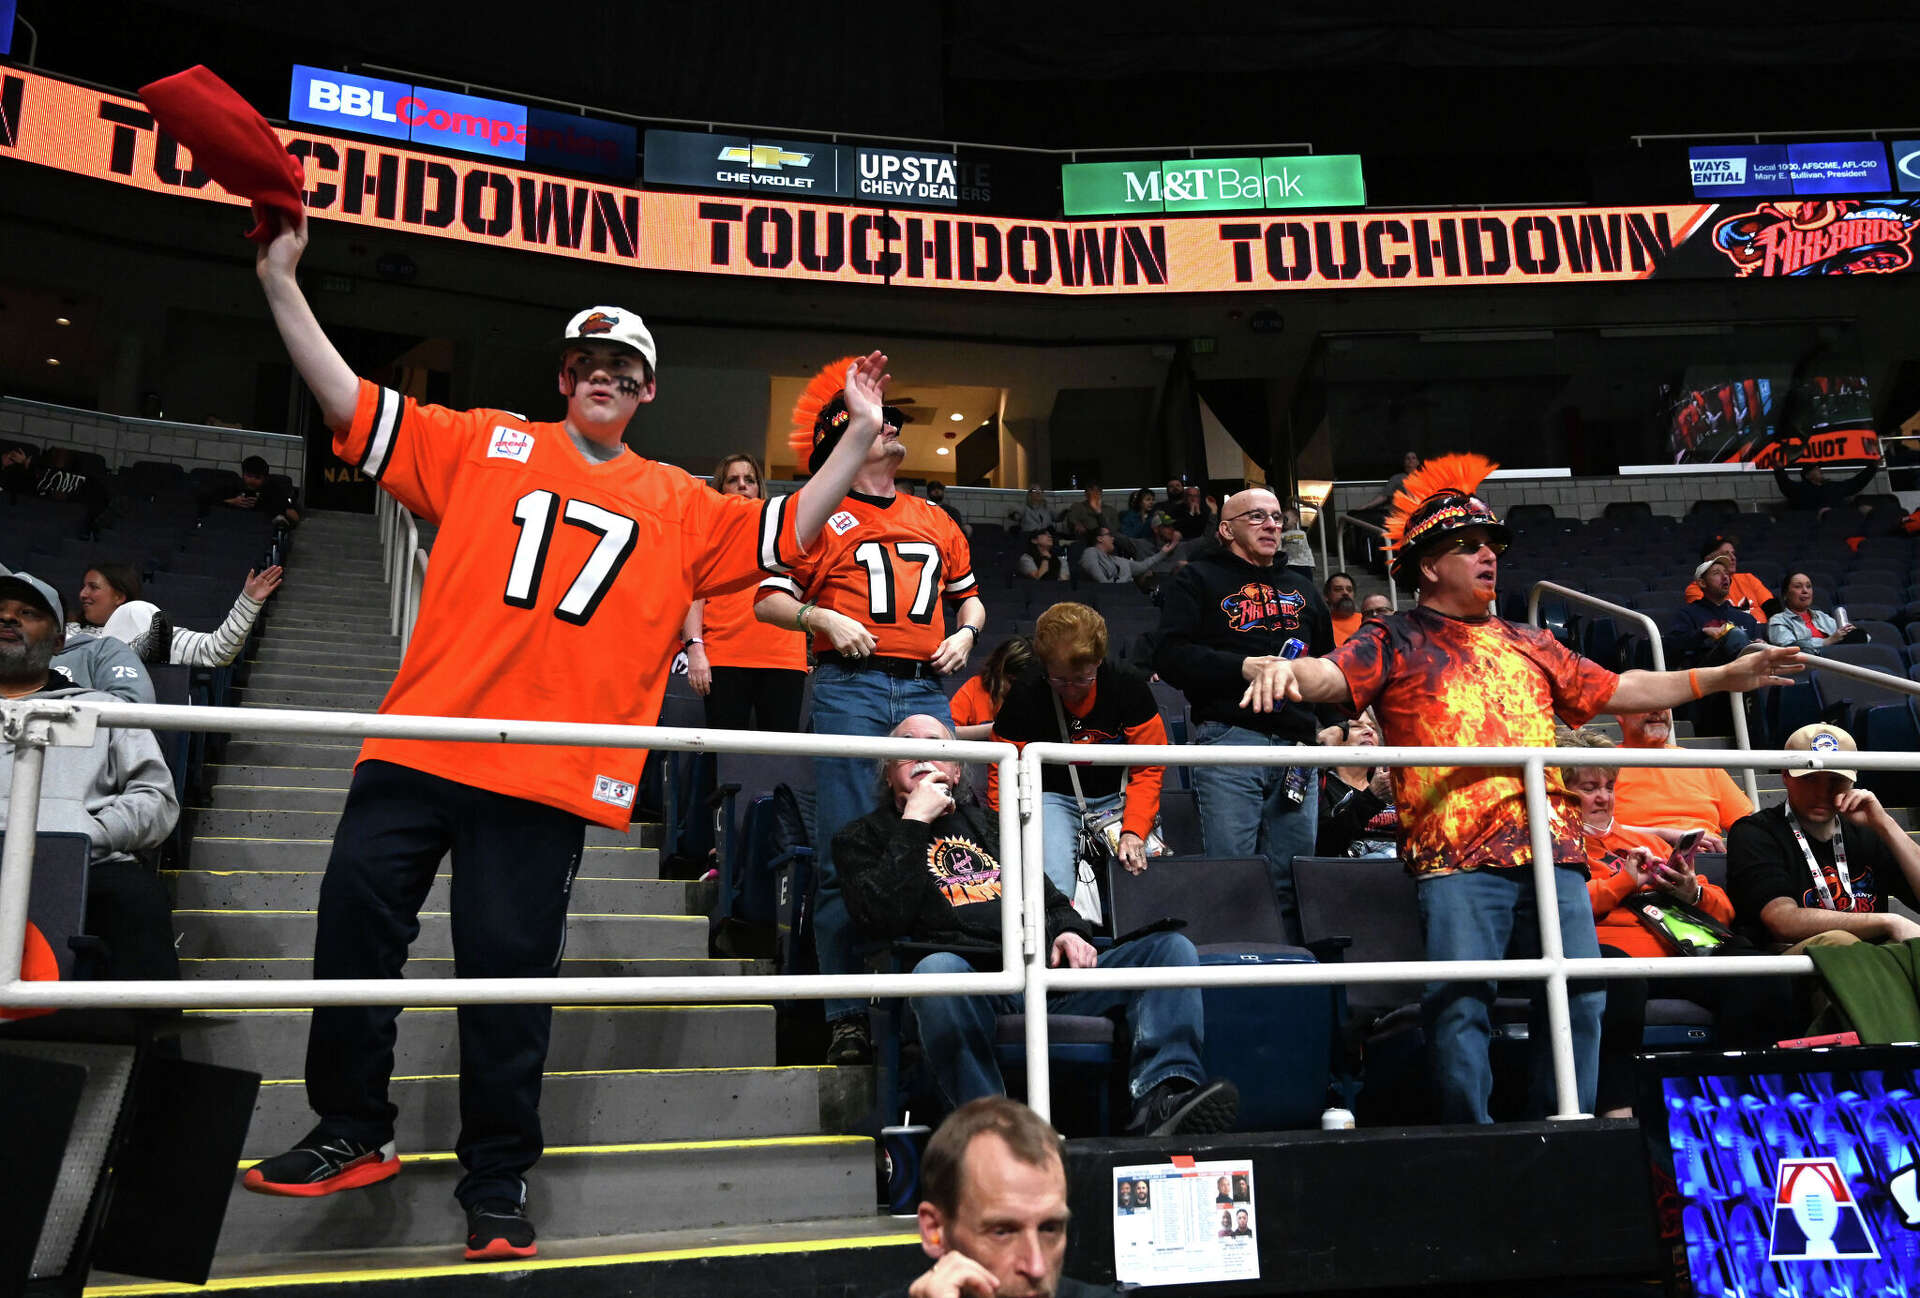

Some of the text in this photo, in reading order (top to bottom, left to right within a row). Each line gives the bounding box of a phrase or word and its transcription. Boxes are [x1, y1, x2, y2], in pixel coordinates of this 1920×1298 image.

[309, 79, 397, 123] BBL
[97, 99, 641, 259] TOCHDOWN
[716, 171, 815, 189] CHEVROLET
[1123, 167, 1304, 202] M&T Bank
[1753, 163, 1777, 172] Local
[1842, 160, 1878, 169] AFL-CIO
[1754, 173, 1776, 182] Mary
[1790, 171, 1826, 181] Sullivan,
[1827, 169, 1868, 179] President
[861, 179, 915, 197] CHEVY
[699, 201, 1169, 287] TOUCHDOWN
[1219, 211, 1669, 283] TOUCHDOWN
[504, 489, 640, 626] 17
[853, 541, 943, 625] 17
[111, 665, 138, 678] 75
